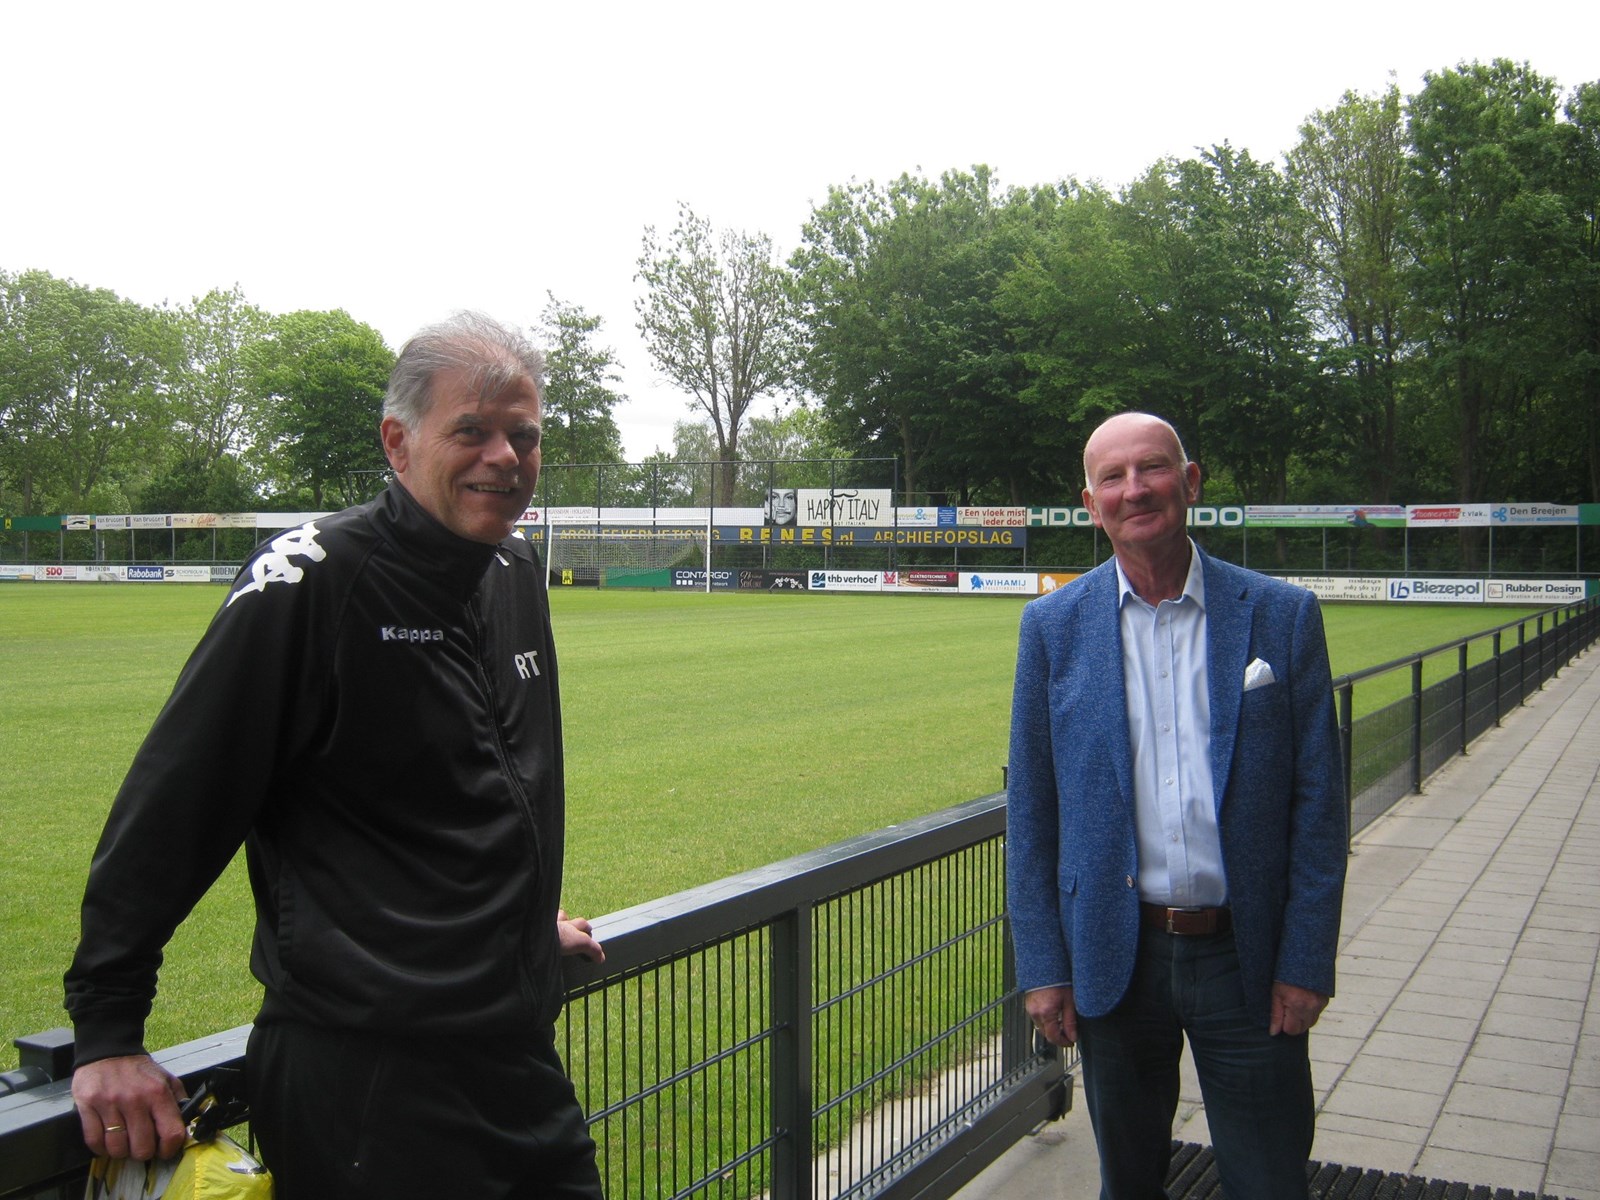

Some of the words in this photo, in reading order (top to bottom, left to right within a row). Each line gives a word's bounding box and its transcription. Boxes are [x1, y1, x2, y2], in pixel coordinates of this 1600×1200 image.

[807, 498, 845, 521] HAPPY
[848, 498, 880, 521] ITALY
[964, 509, 980, 517] Een
[982, 508, 1004, 517] vloek
[1006, 508, 1026, 517] mist
[1509, 507, 1529, 515] Den
[1530, 507, 1567, 516] Breejen
[982, 517, 1004, 526] ieder
[1006, 517, 1025, 526] doel
[873, 531, 1013, 545] ARCHIEFOPSLAG
[45, 567, 63, 576] SDO
[128, 567, 163, 579] Rabobank
[210, 567, 239, 576] OUDEMA
[827, 574, 842, 583] thb
[843, 574, 878, 584] verhoef
[985, 579, 1027, 587] WIHAMIJ
[1412, 581, 1480, 597] Biezepol
[1505, 583, 1543, 593] Rubber
[1545, 583, 1582, 595] Design
[381, 626, 445, 643] Kappa
[514, 650, 541, 680] RT
